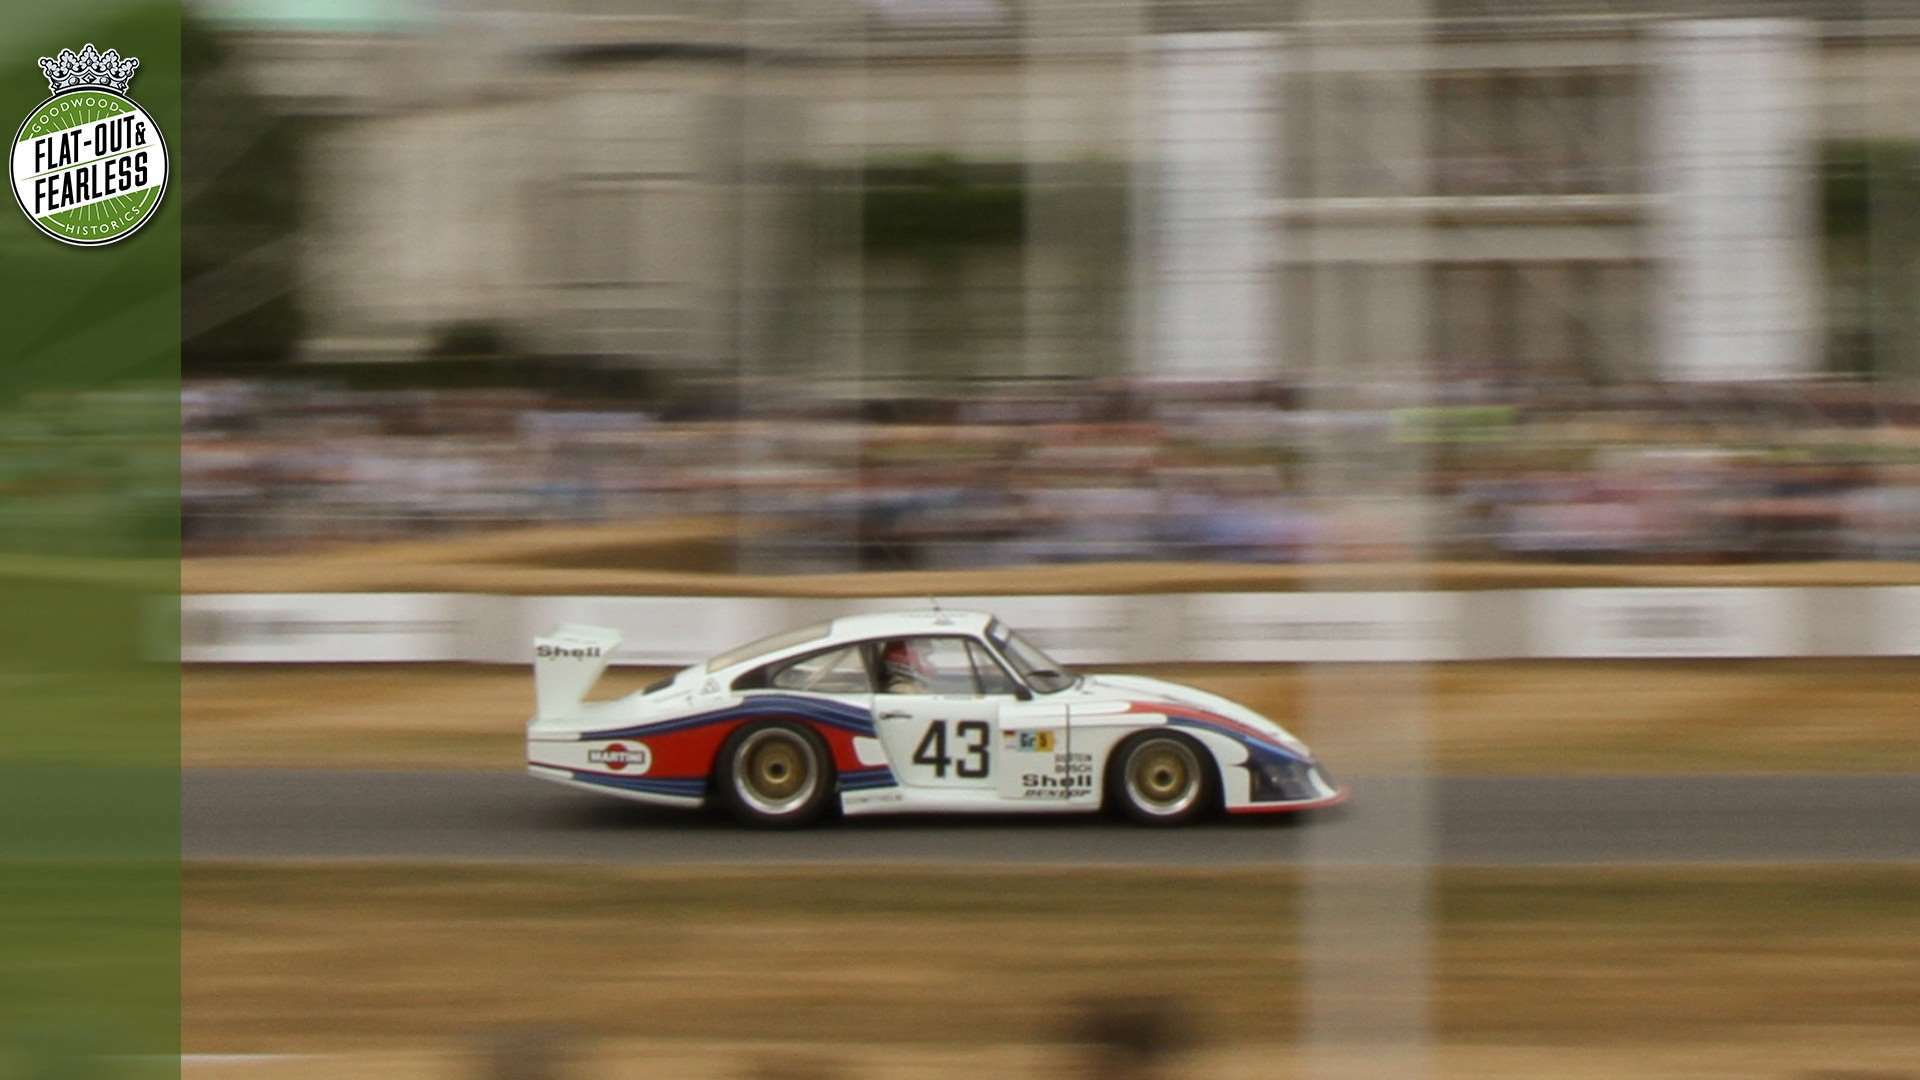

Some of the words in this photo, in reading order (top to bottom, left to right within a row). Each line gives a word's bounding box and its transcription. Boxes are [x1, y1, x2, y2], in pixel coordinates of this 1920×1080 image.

[536, 645, 601, 657] Shell
[913, 720, 990, 778] 43
[591, 751, 642, 762] MARTINI
[1022, 774, 1092, 787] Shell
